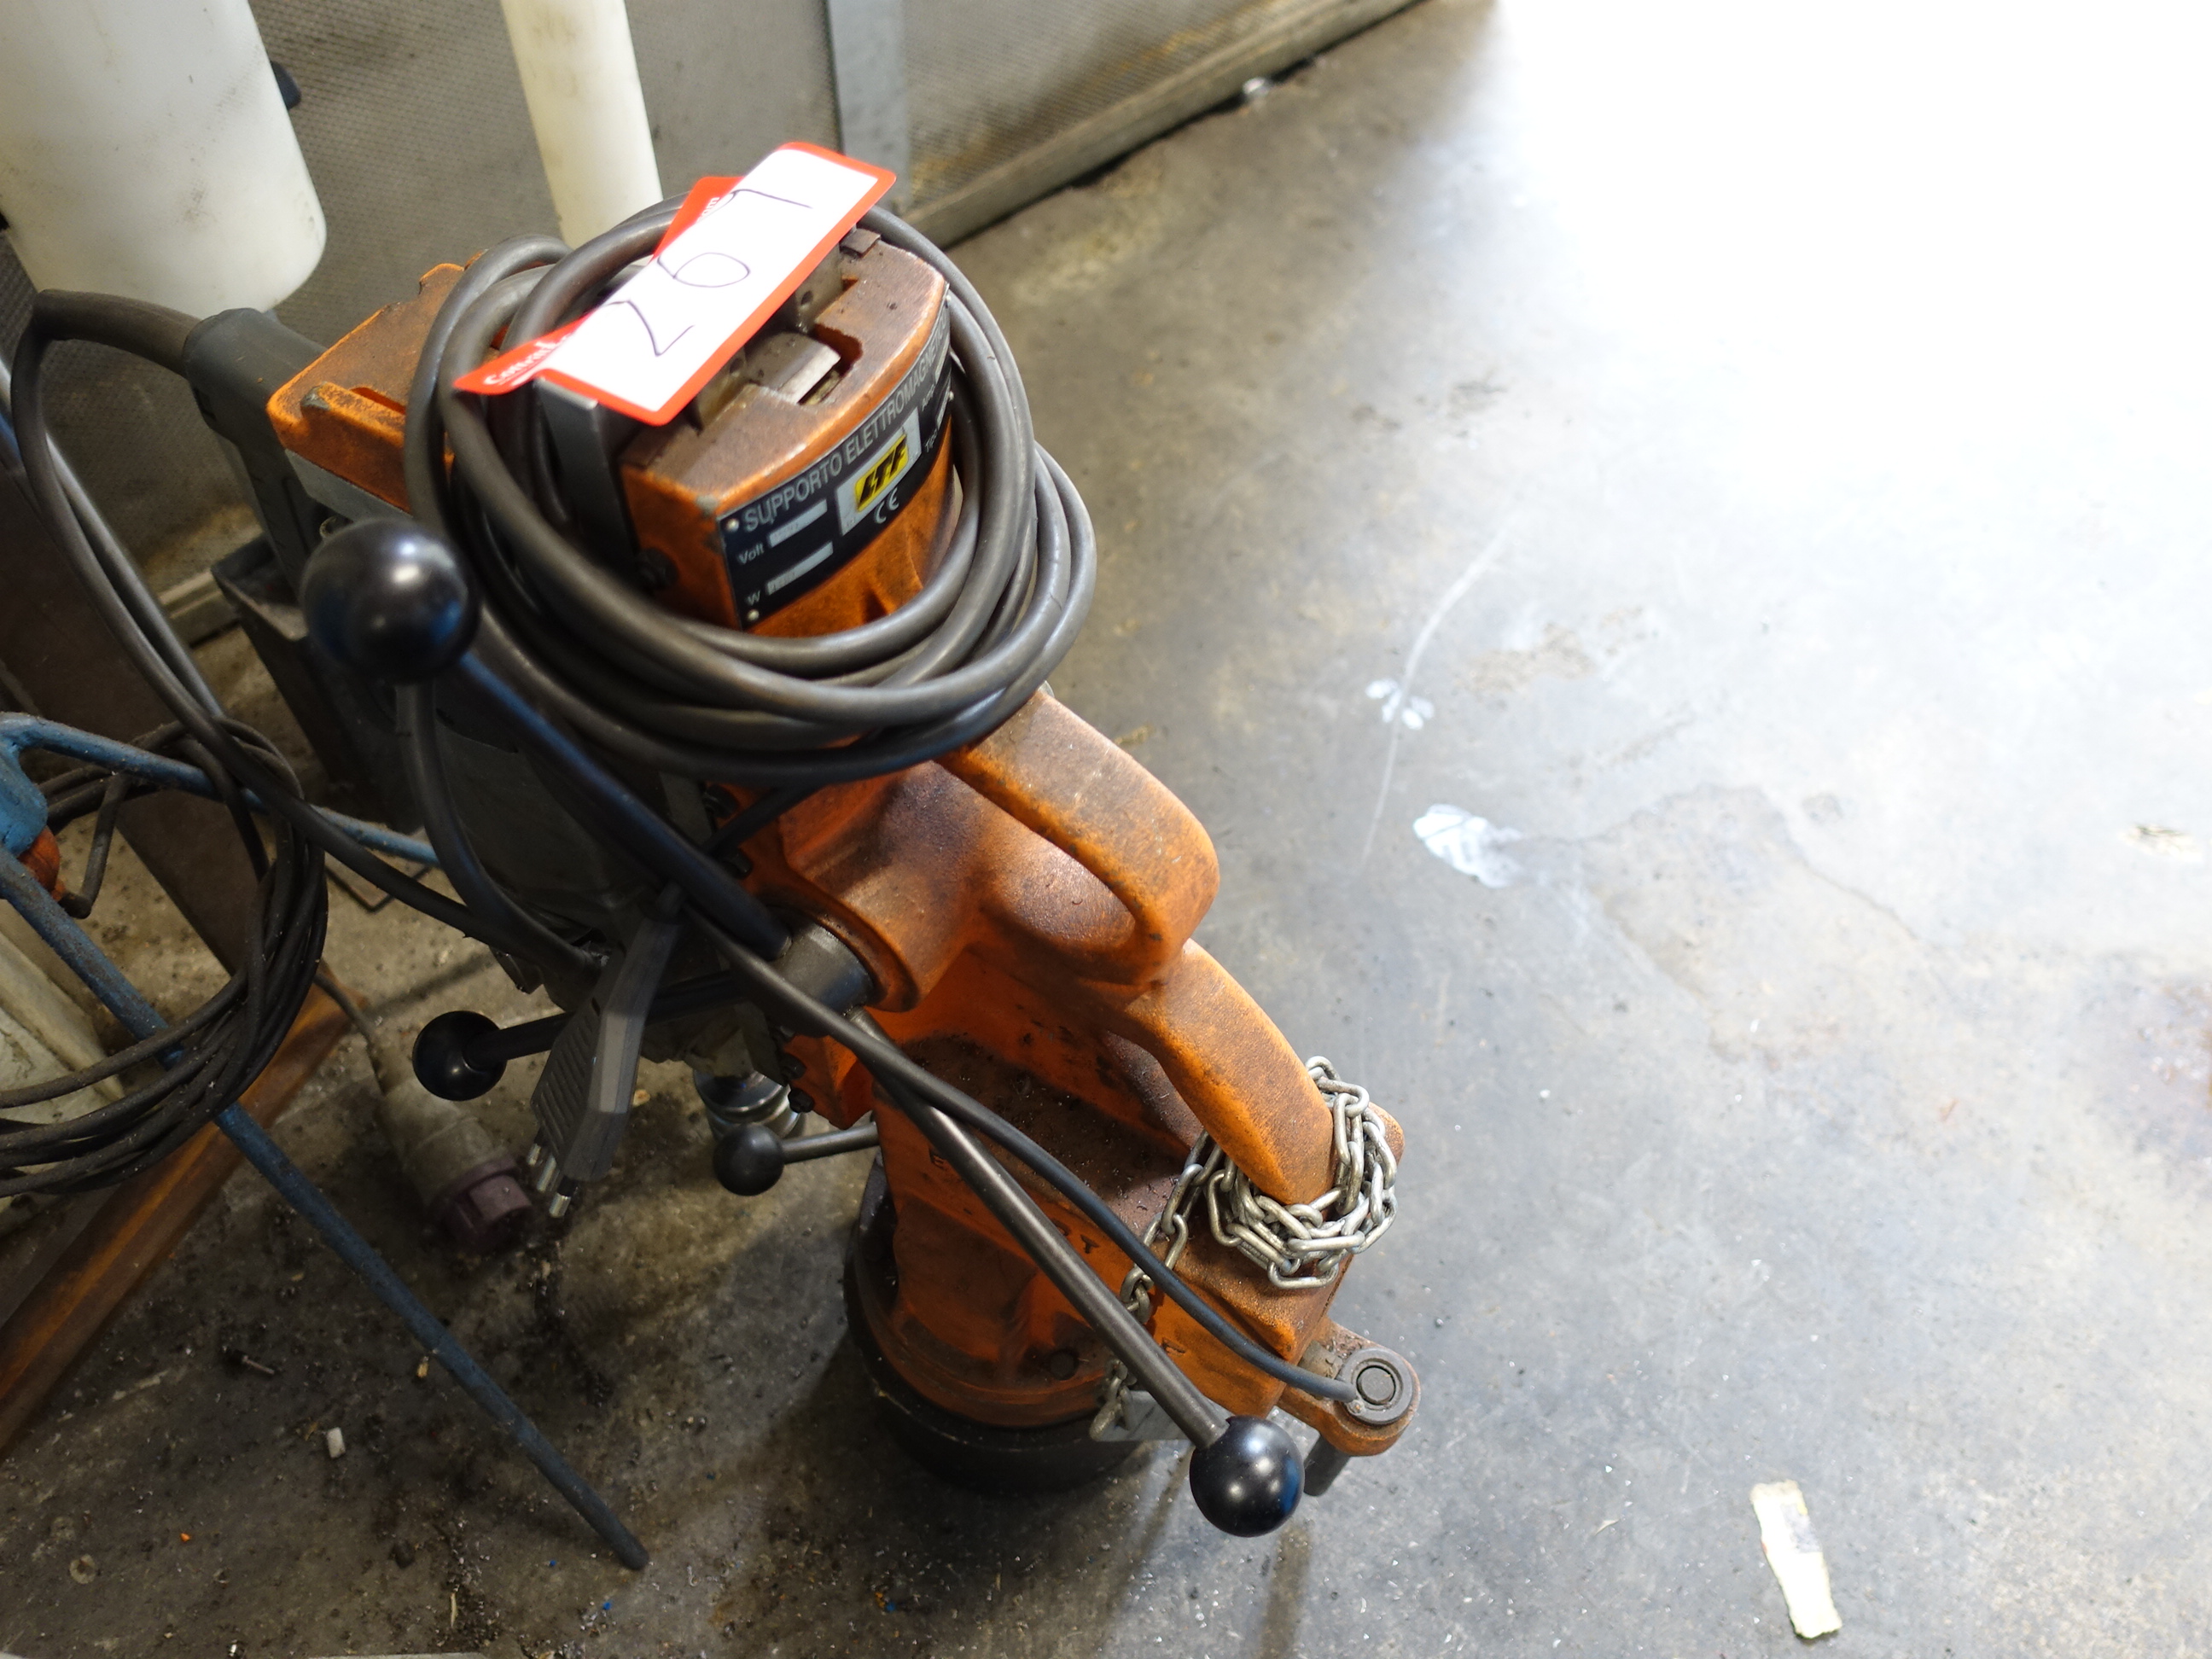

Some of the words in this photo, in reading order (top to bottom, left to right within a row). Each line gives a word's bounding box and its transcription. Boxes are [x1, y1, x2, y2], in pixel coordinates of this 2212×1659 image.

[742, 451, 842, 533] SUPPORTO
[737, 543, 765, 565] Volt
[747, 591, 760, 606] W
